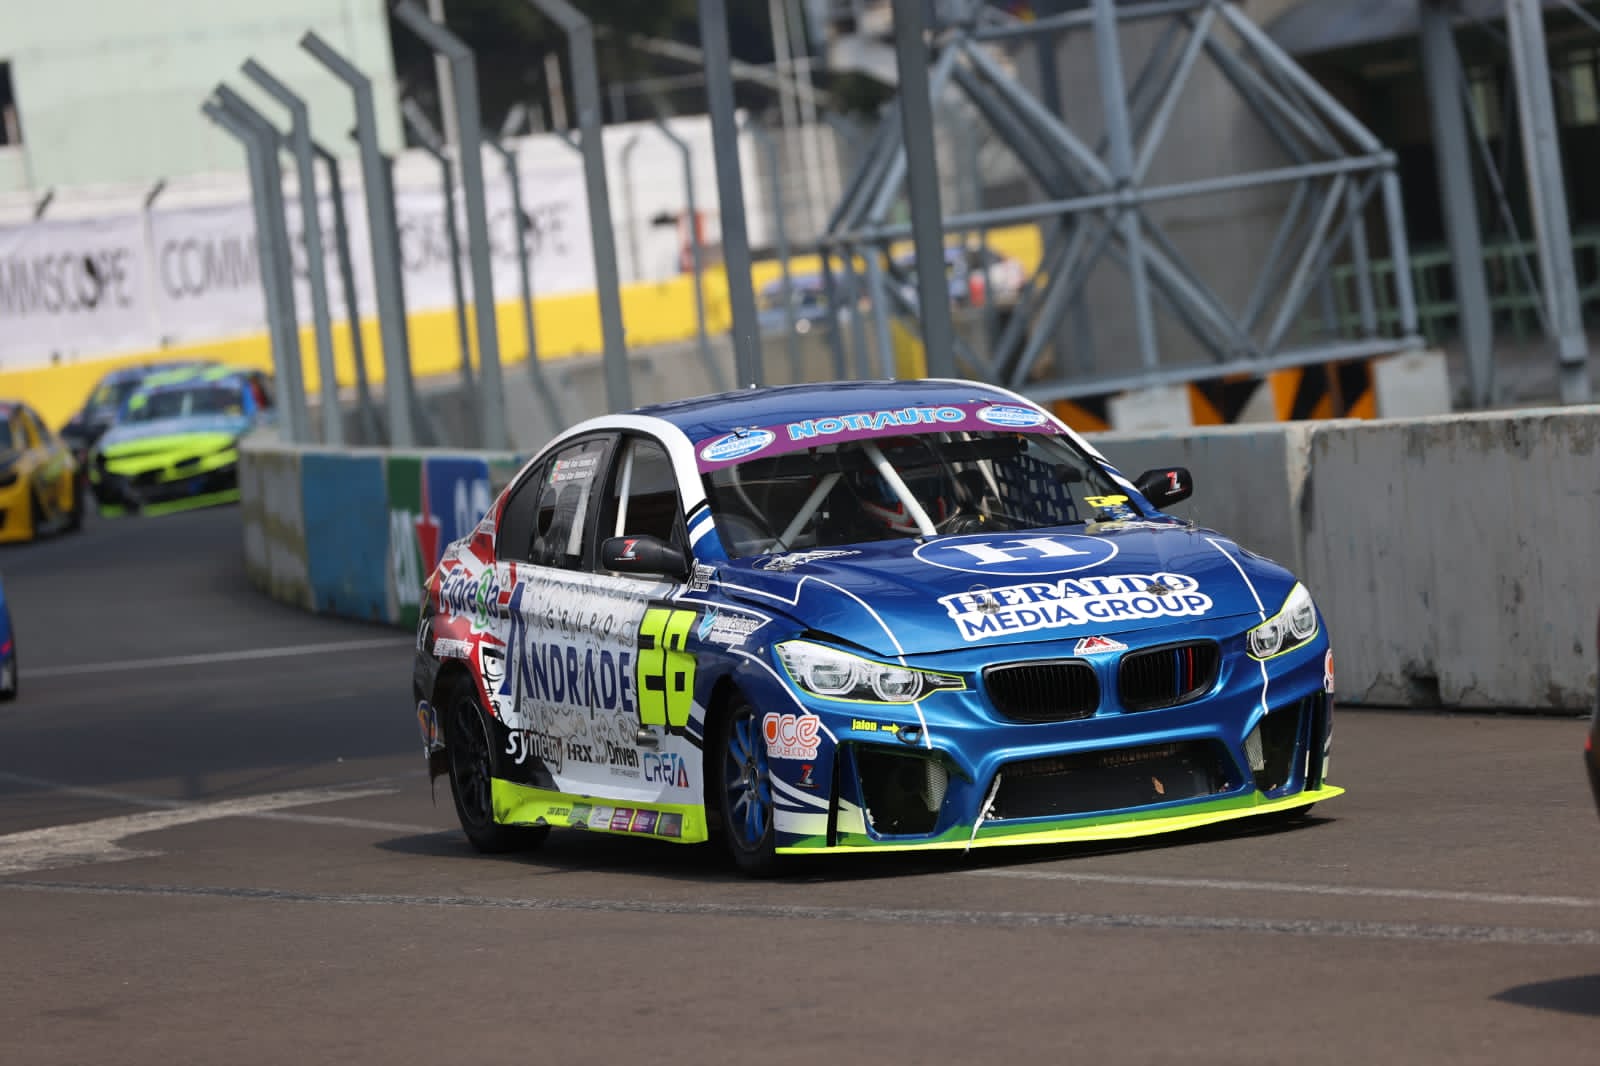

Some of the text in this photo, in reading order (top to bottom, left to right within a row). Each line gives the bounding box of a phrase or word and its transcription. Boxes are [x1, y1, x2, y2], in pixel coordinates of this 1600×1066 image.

[787, 407, 965, 440] NOTIAUTO
[940, 536, 1091, 565] H
[947, 577, 1193, 615] HERALDO
[545, 608, 614, 635] GRUPO
[962, 595, 1207, 637] MEDIA GROUP
[499, 582, 634, 720] ANDRADE
[638, 608, 697, 726] 28
[852, 718, 878, 732] jalon
[567, 743, 593, 762] HRX
[607, 740, 639, 768] Driven
